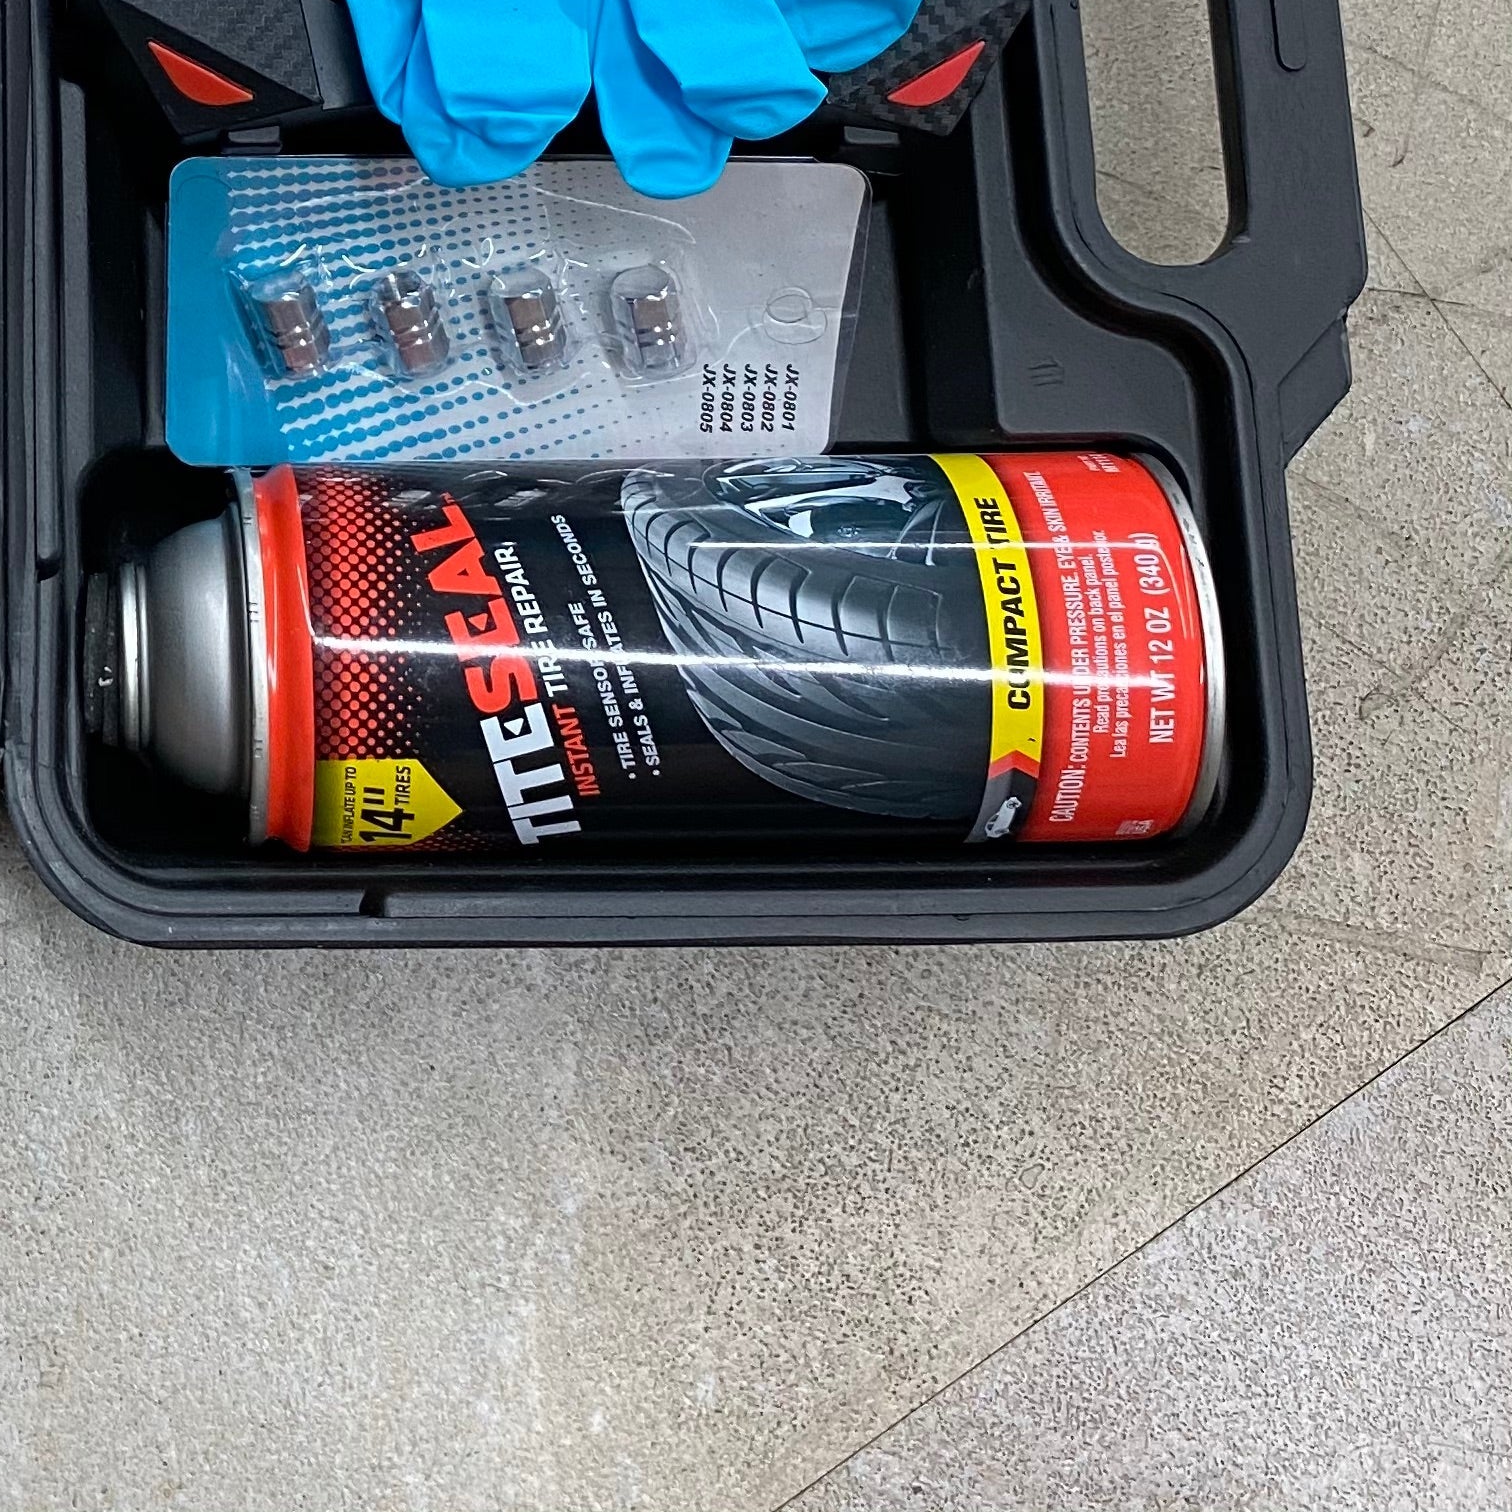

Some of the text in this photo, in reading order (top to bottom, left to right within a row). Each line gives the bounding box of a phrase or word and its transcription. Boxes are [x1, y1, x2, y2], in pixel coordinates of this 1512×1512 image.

[700, 363, 716, 433] JX-0805
[720, 363, 736, 433] JX-0804
[741, 363, 757, 433] JX-0803
[761, 363, 778, 433] JX-0802
[782, 363, 799, 433] JX-0801
[1042, 507, 1066, 532] SKIN
[1100, 577, 1125, 609] panel
[1138, 555, 1171, 595] (340
[974, 496, 1032, 710] COMPACT TIRE
[1106, 610, 1125, 622] el
[1144, 607, 1172, 633] OZ
[551, 514, 661, 766] SEALS & INFATES IN SECONDS
[568, 602, 596, 650] SAFE
[1077, 554, 1112, 733] Read preautions on back panel.
[1109, 624, 1126, 640] en
[532, 639, 570, 697] TIRE
[1070, 647, 1090, 694] UDER
[1149, 640, 1174, 664] 12
[1109, 642, 1131, 718] precaciones
[1151, 673, 1176, 702] WT
[1071, 699, 1092, 763] CONTENTS
[1111, 720, 1128, 737] las
[1150, 708, 1175, 743] NET
[552, 703, 600, 796] INSTANT
[612, 732, 636, 769] TIRE
[1109, 740, 1127, 758] Lea
[345, 767, 356, 779] TO
[345, 783, 355, 795] UP
[395, 766, 410, 805] TIRES
[1049, 764, 1087, 822] CAUTION:
[342, 798, 355, 830] INFLATE
